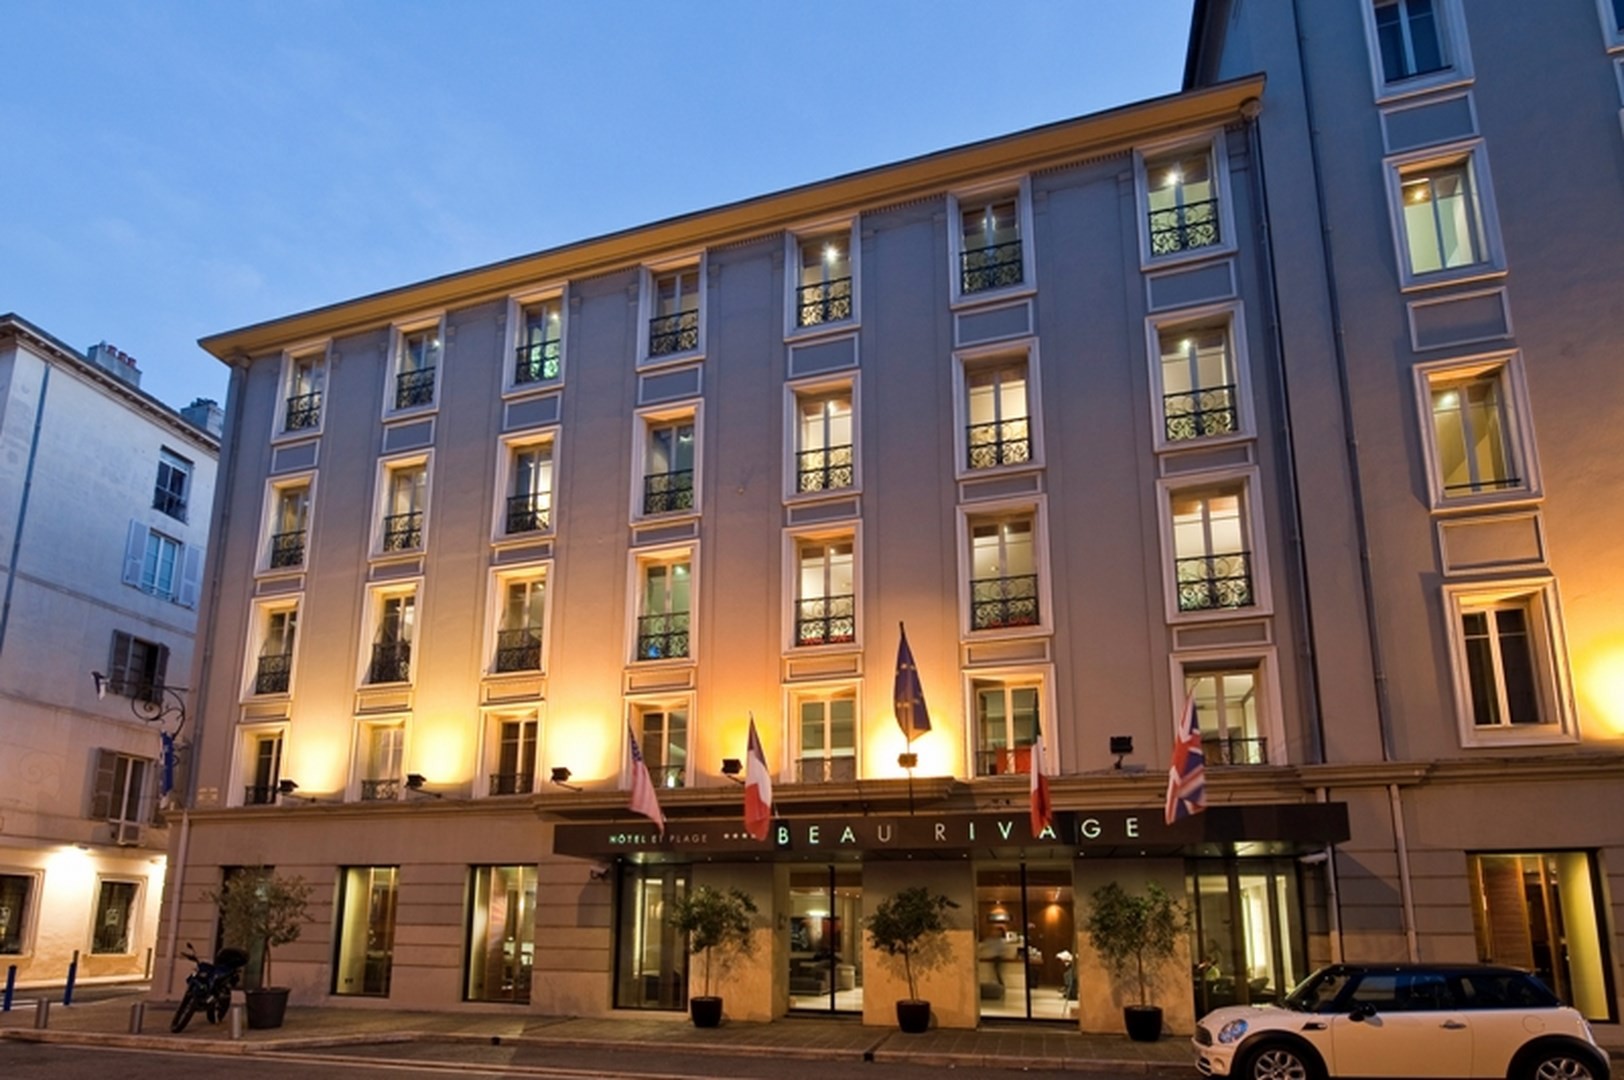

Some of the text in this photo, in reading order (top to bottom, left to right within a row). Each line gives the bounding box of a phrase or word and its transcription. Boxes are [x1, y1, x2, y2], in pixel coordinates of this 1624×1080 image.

[608, 833, 646, 844] HÔTEL
[669, 834, 707, 844] PLAGE
[777, 818, 1139, 844] BEAU RIVAGE
